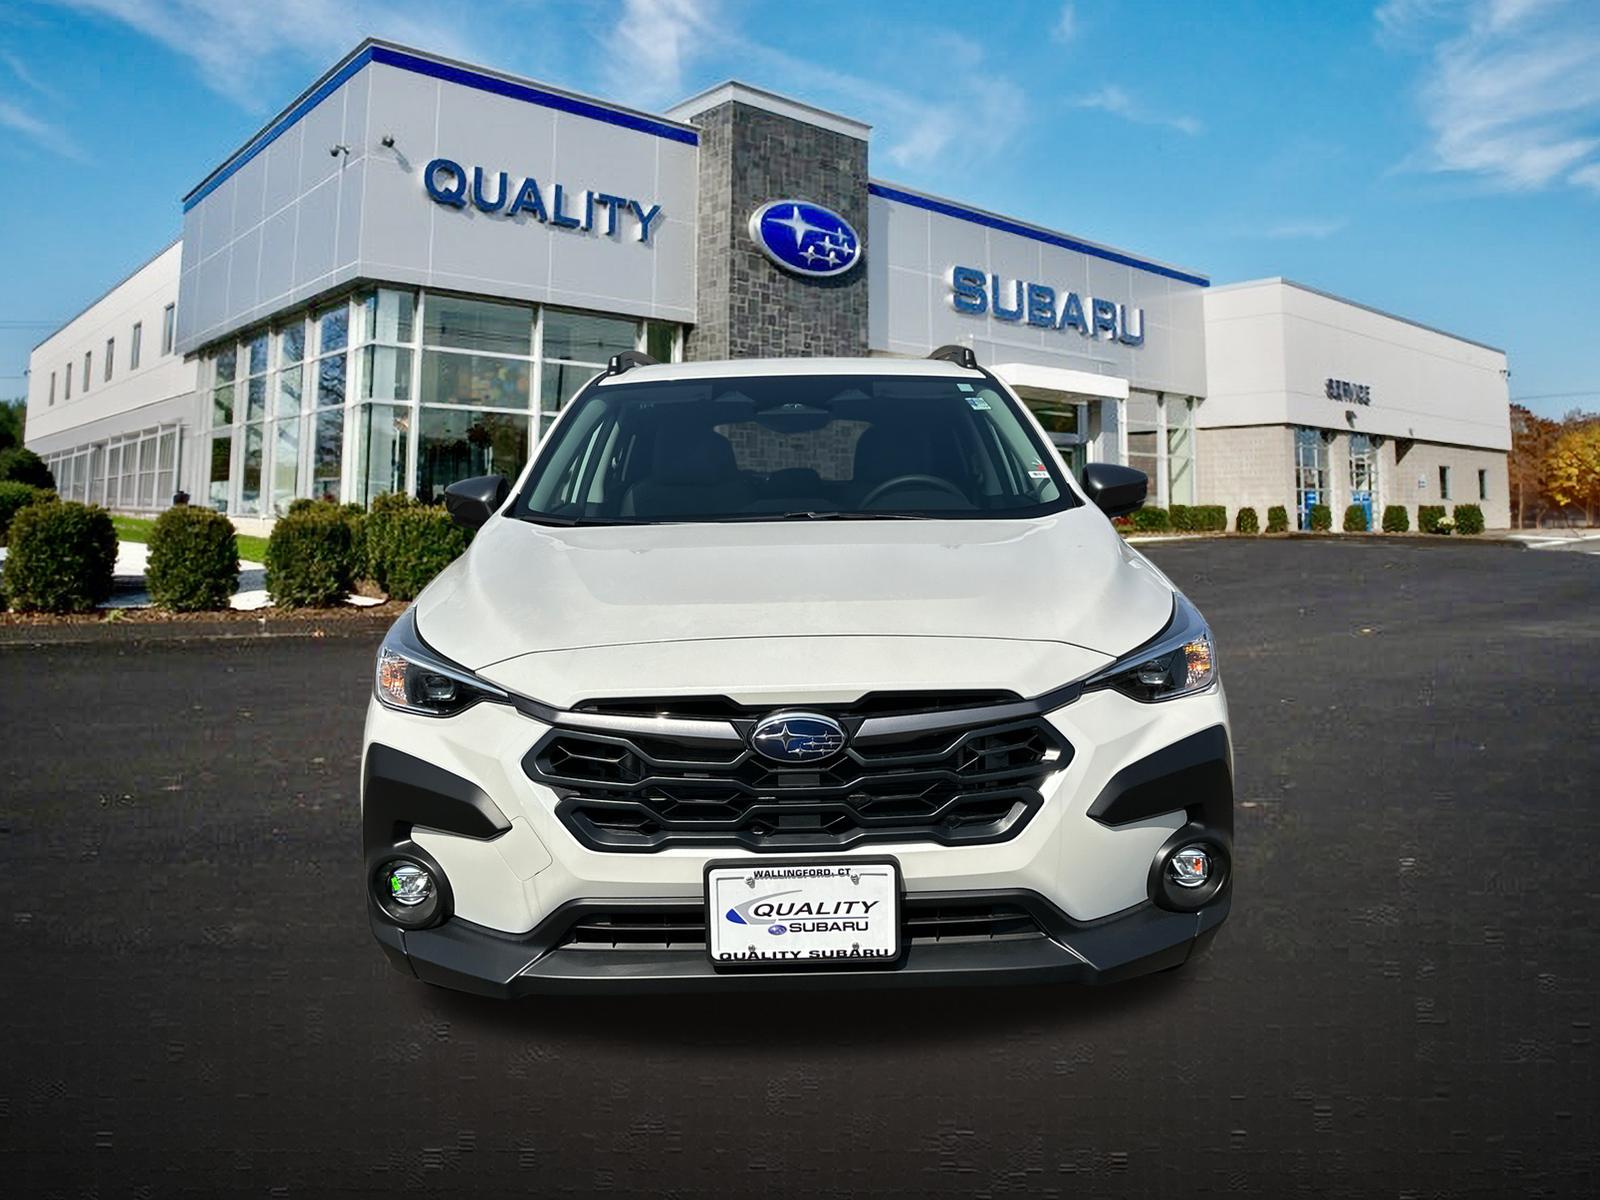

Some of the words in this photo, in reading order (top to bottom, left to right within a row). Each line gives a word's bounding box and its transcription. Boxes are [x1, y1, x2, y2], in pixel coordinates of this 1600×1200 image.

[424, 158, 661, 242] QUALITY
[951, 265, 1145, 346] SUBARU
[1325, 378, 1371, 406] SERVICE
[838, 868, 851, 876] CT
[753, 901, 880, 917] QUALITY
[789, 921, 869, 933] SUBARU
[719, 950, 802, 961] QUALITY
[809, 948, 889, 959] SUBARU
